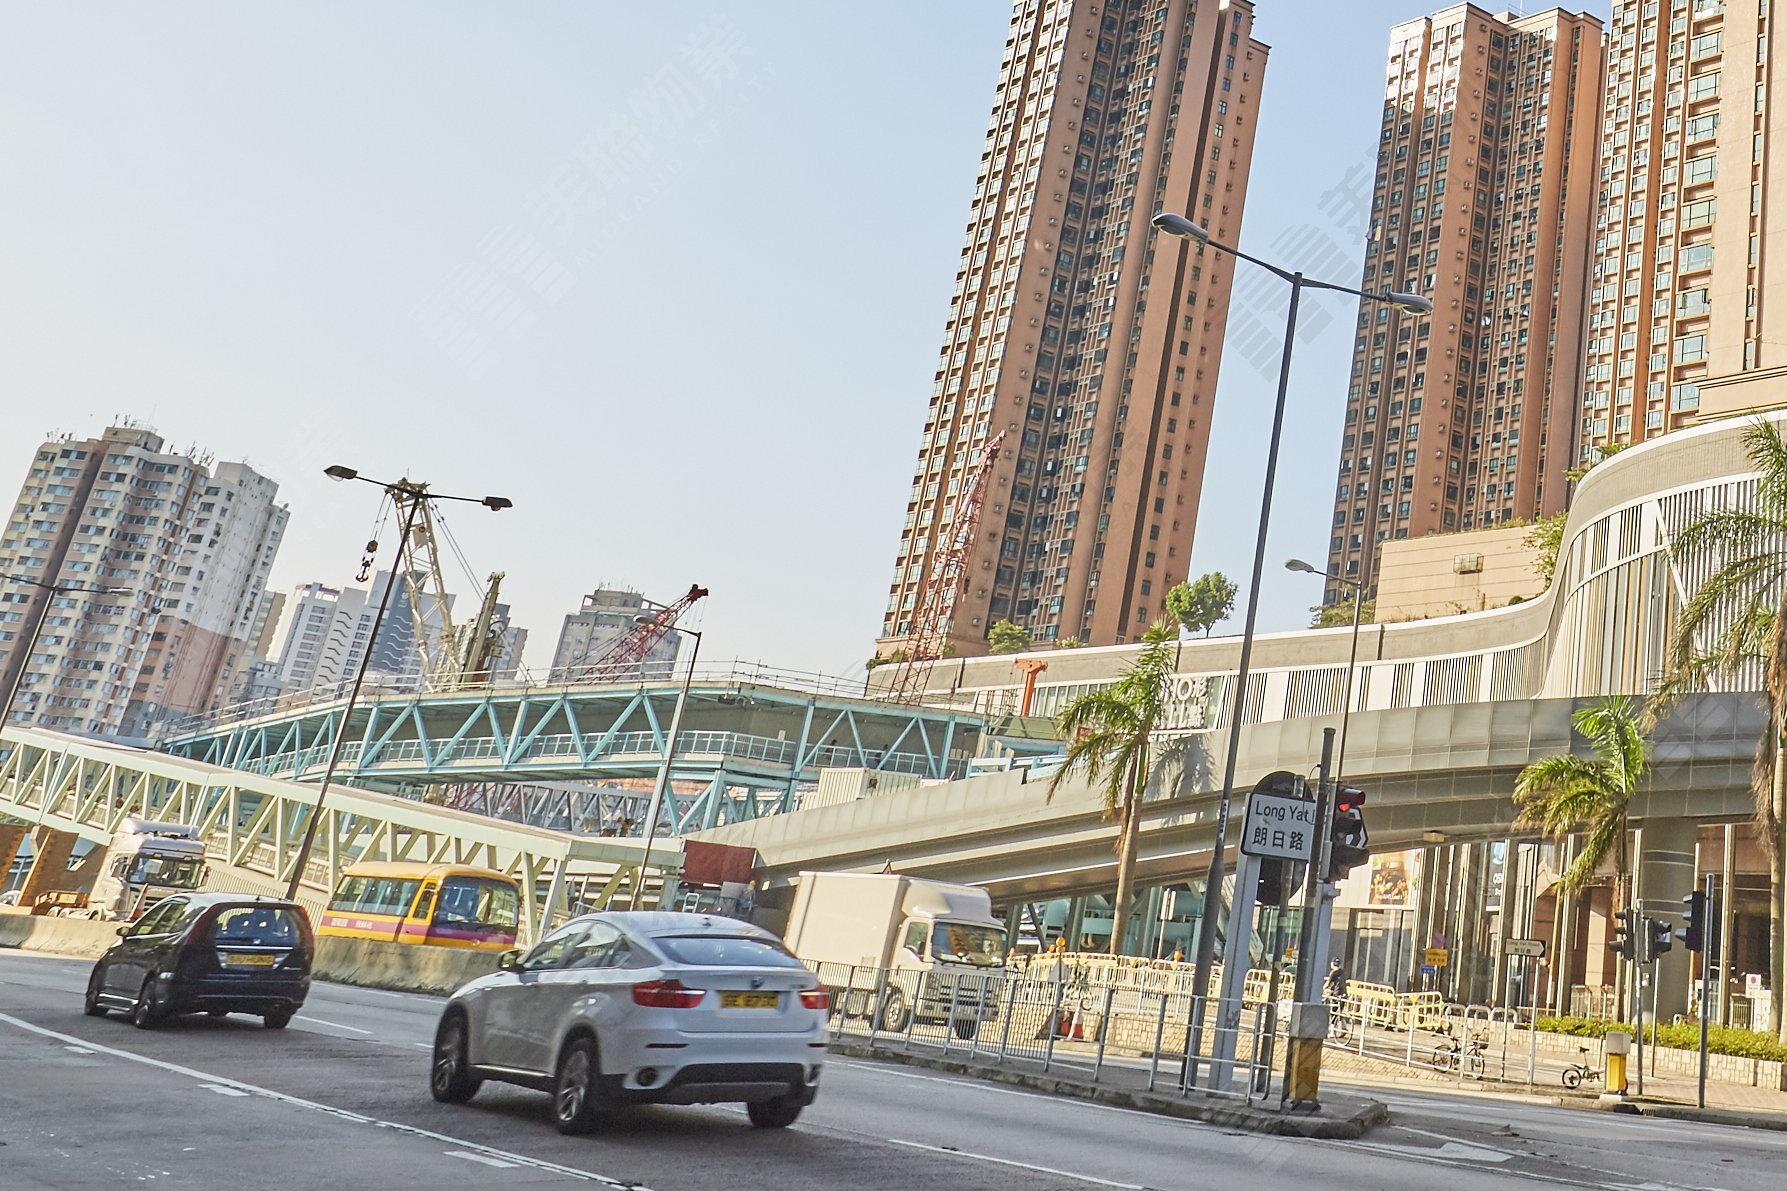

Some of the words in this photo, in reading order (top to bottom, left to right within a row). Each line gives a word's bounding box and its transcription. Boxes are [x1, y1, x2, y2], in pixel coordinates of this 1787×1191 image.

[1255, 800, 1286, 821] Long
[1289, 806, 1309, 822] Yat
[1252, 826, 1304, 850] 朗日路
